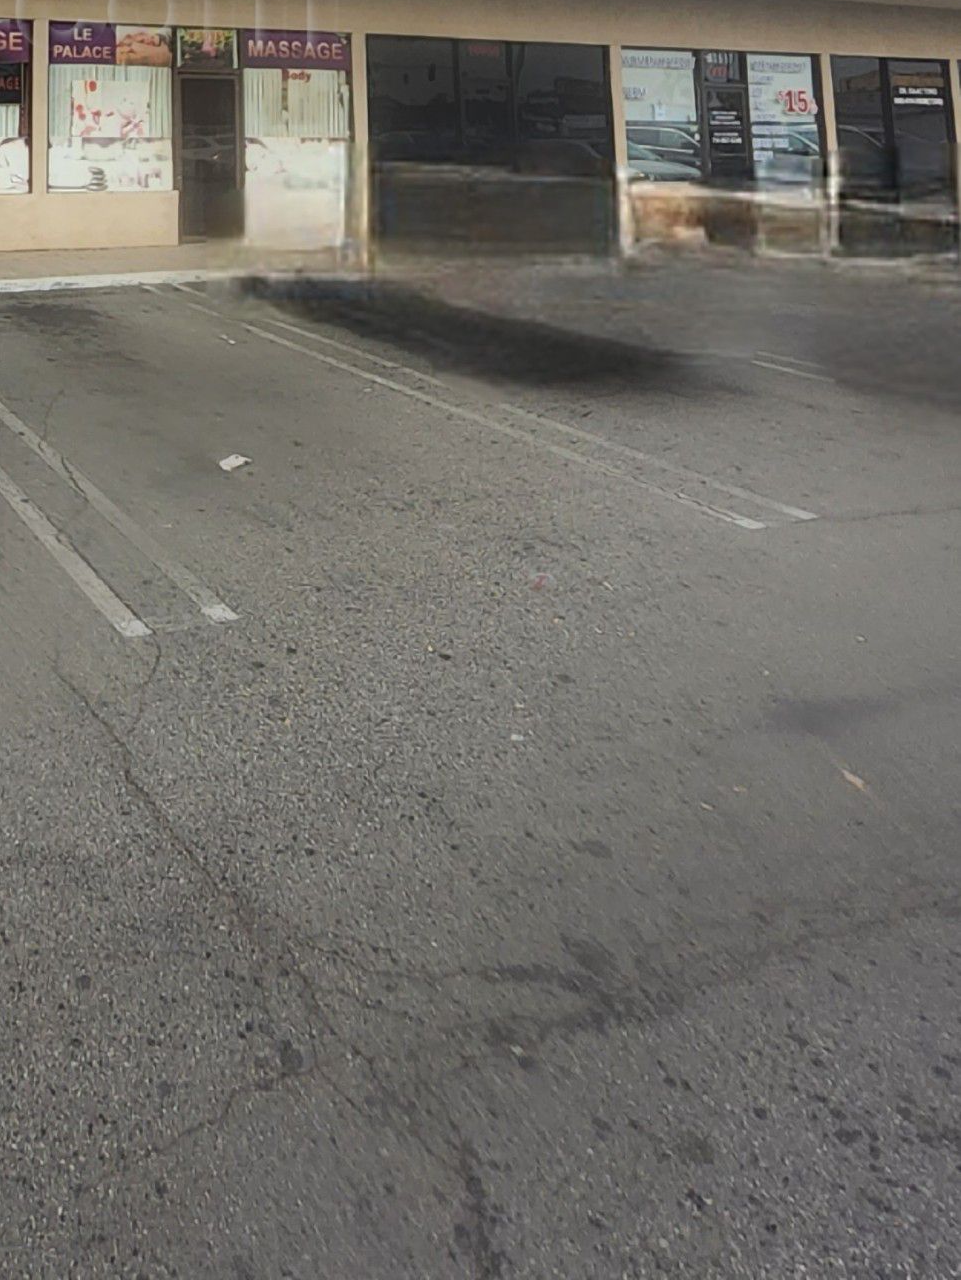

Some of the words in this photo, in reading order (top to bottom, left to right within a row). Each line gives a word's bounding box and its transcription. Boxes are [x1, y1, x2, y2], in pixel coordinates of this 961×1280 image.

[73, 27, 94, 41] LE
[53, 44, 113, 59] PALACE
[247, 39, 344, 60] MASSAGE
